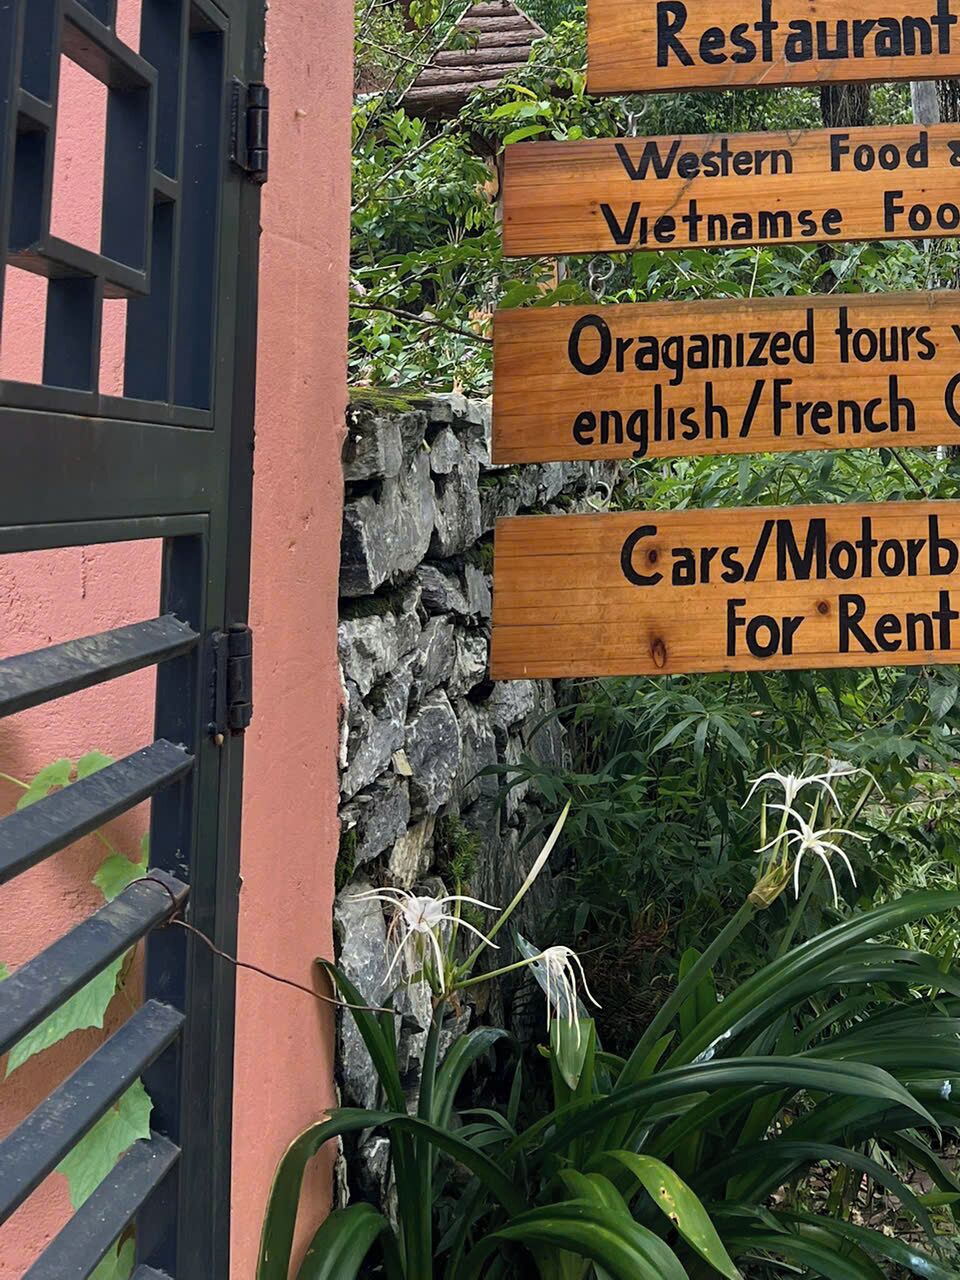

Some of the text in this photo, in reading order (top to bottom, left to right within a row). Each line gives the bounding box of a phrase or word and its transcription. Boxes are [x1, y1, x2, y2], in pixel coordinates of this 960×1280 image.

[615, 140, 793, 181] Western
[830, 131, 929, 172] Food
[600, 199, 844, 246] Vietnamse
[567, 308, 815, 386] Oraganized
[835, 306, 937, 362] tours
[727, 590, 960, 658] For Rent
